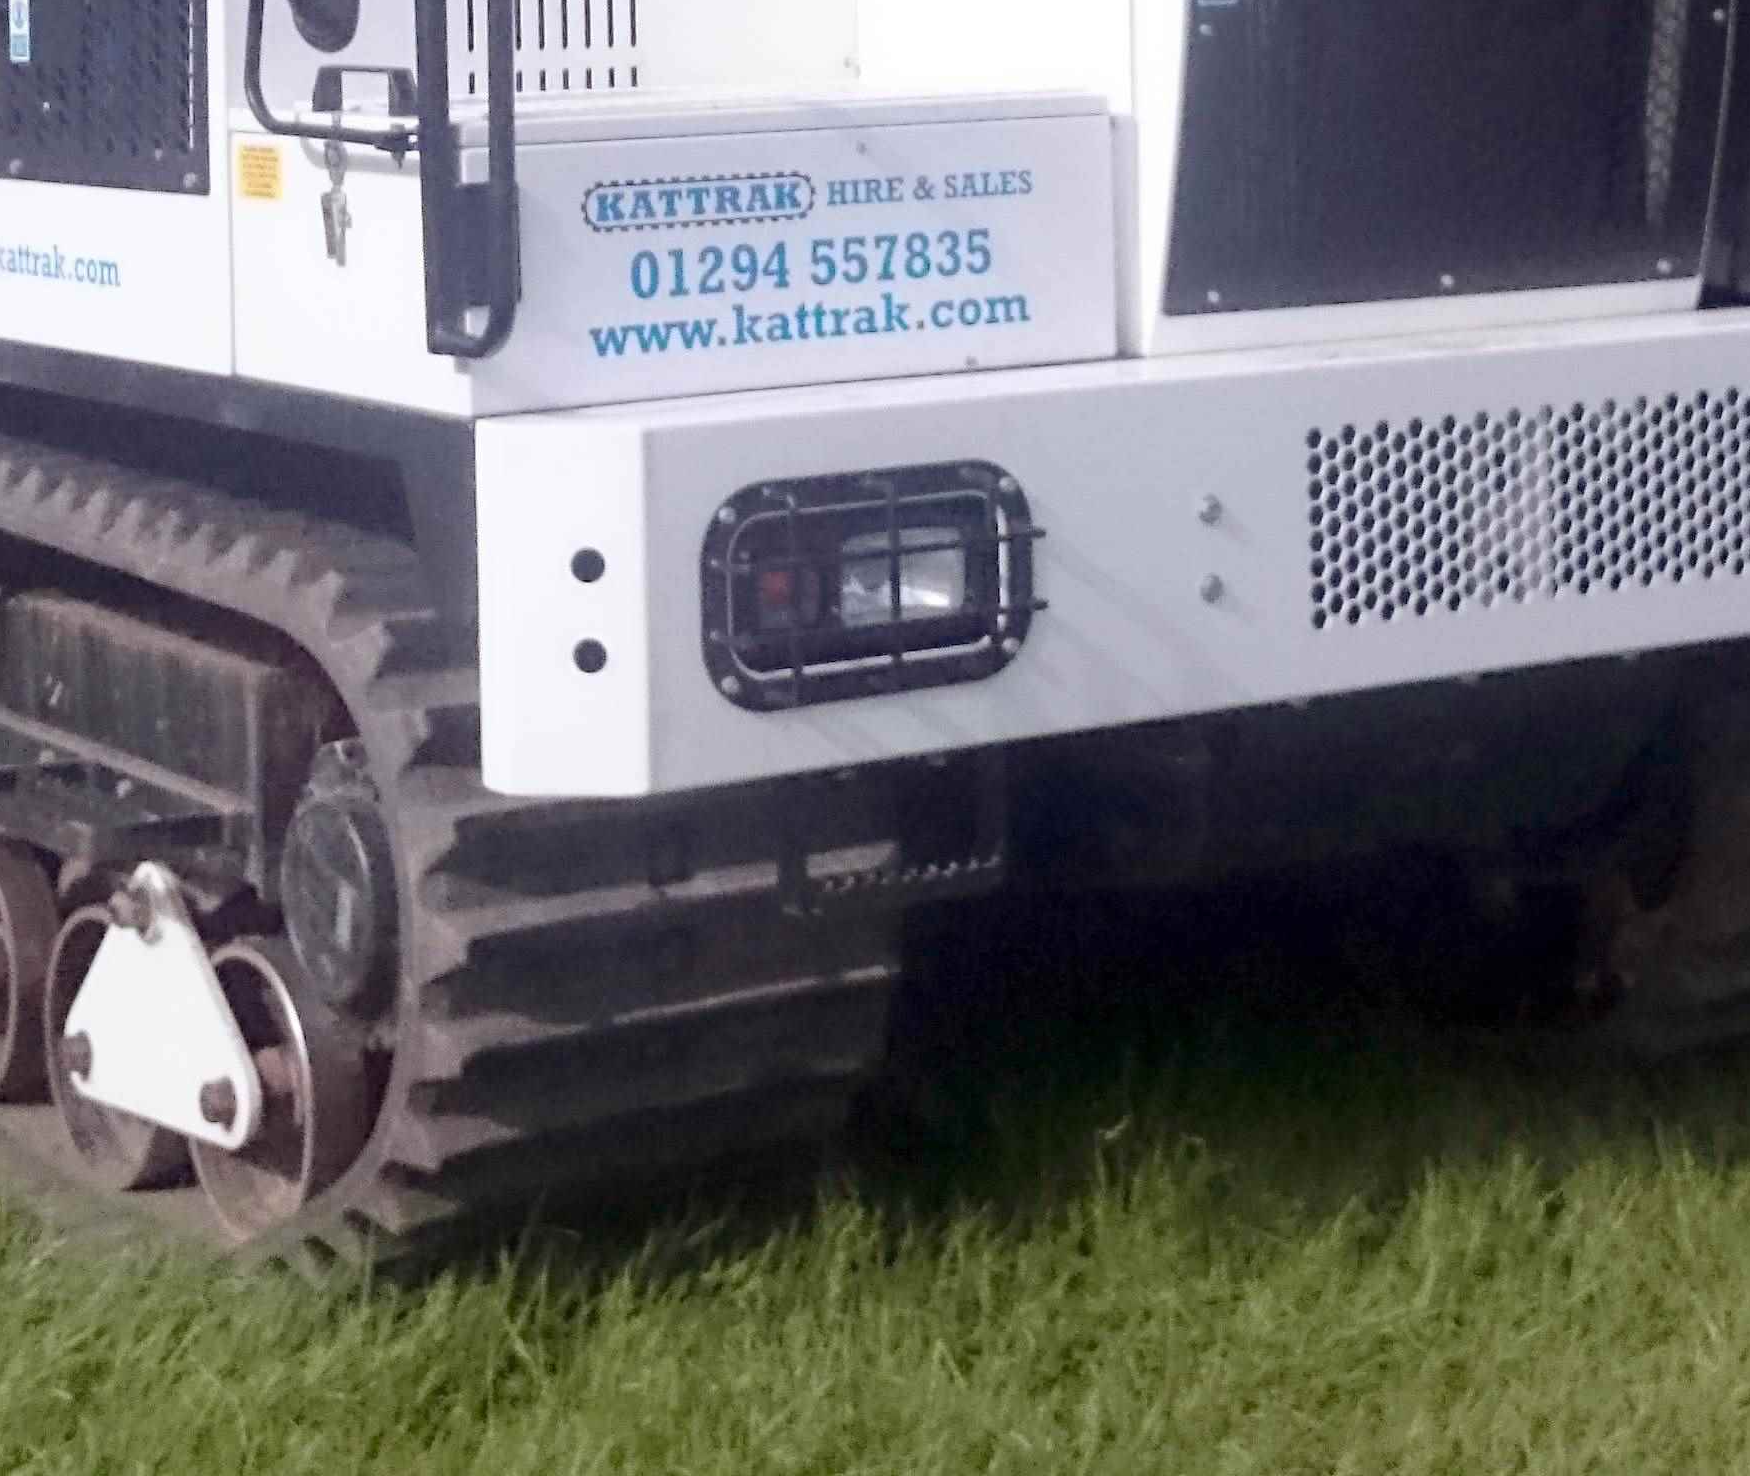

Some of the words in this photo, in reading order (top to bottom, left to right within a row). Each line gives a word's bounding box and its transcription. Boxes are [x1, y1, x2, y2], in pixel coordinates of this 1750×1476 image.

[595, 181, 802, 222] KATTRAK
[826, 177, 904, 206] HIRE
[912, 175, 936, 200] &
[944, 170, 1033, 198] SALES
[630, 241, 790, 299] 01294
[811, 228, 991, 286] 557835
[589, 292, 1030, 357] www.kattrak.com
